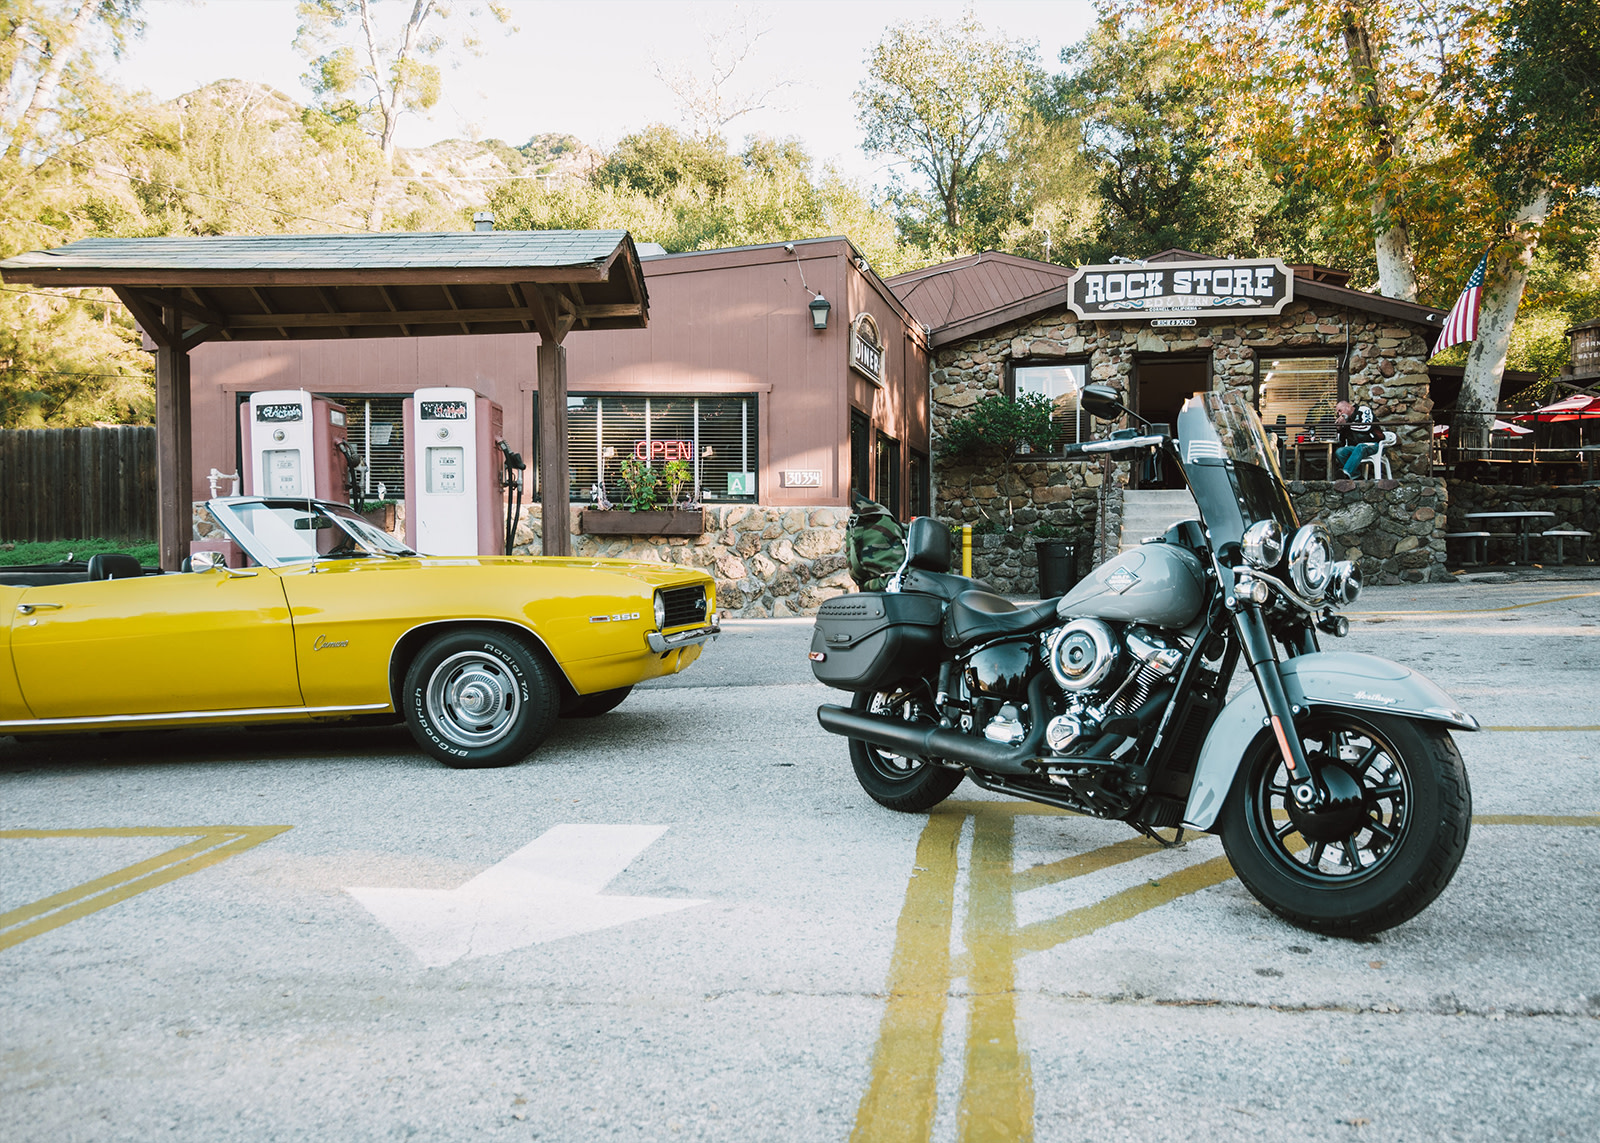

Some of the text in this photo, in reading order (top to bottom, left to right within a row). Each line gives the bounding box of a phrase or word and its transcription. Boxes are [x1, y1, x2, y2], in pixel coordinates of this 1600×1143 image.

[1085, 267, 1275, 304] ROCK STORE
[855, 337, 880, 375] DINER
[1577, 351, 1600, 359] WATE
[636, 441, 692, 460] OPEN
[730, 478, 743, 491] A
[786, 471, 820, 485] 30354
[612, 612, 640, 622] 350
[313, 634, 349, 651] Camaro
[483, 643, 529, 702] Radial T/A
[414, 687, 469, 757] BFGoodrich
